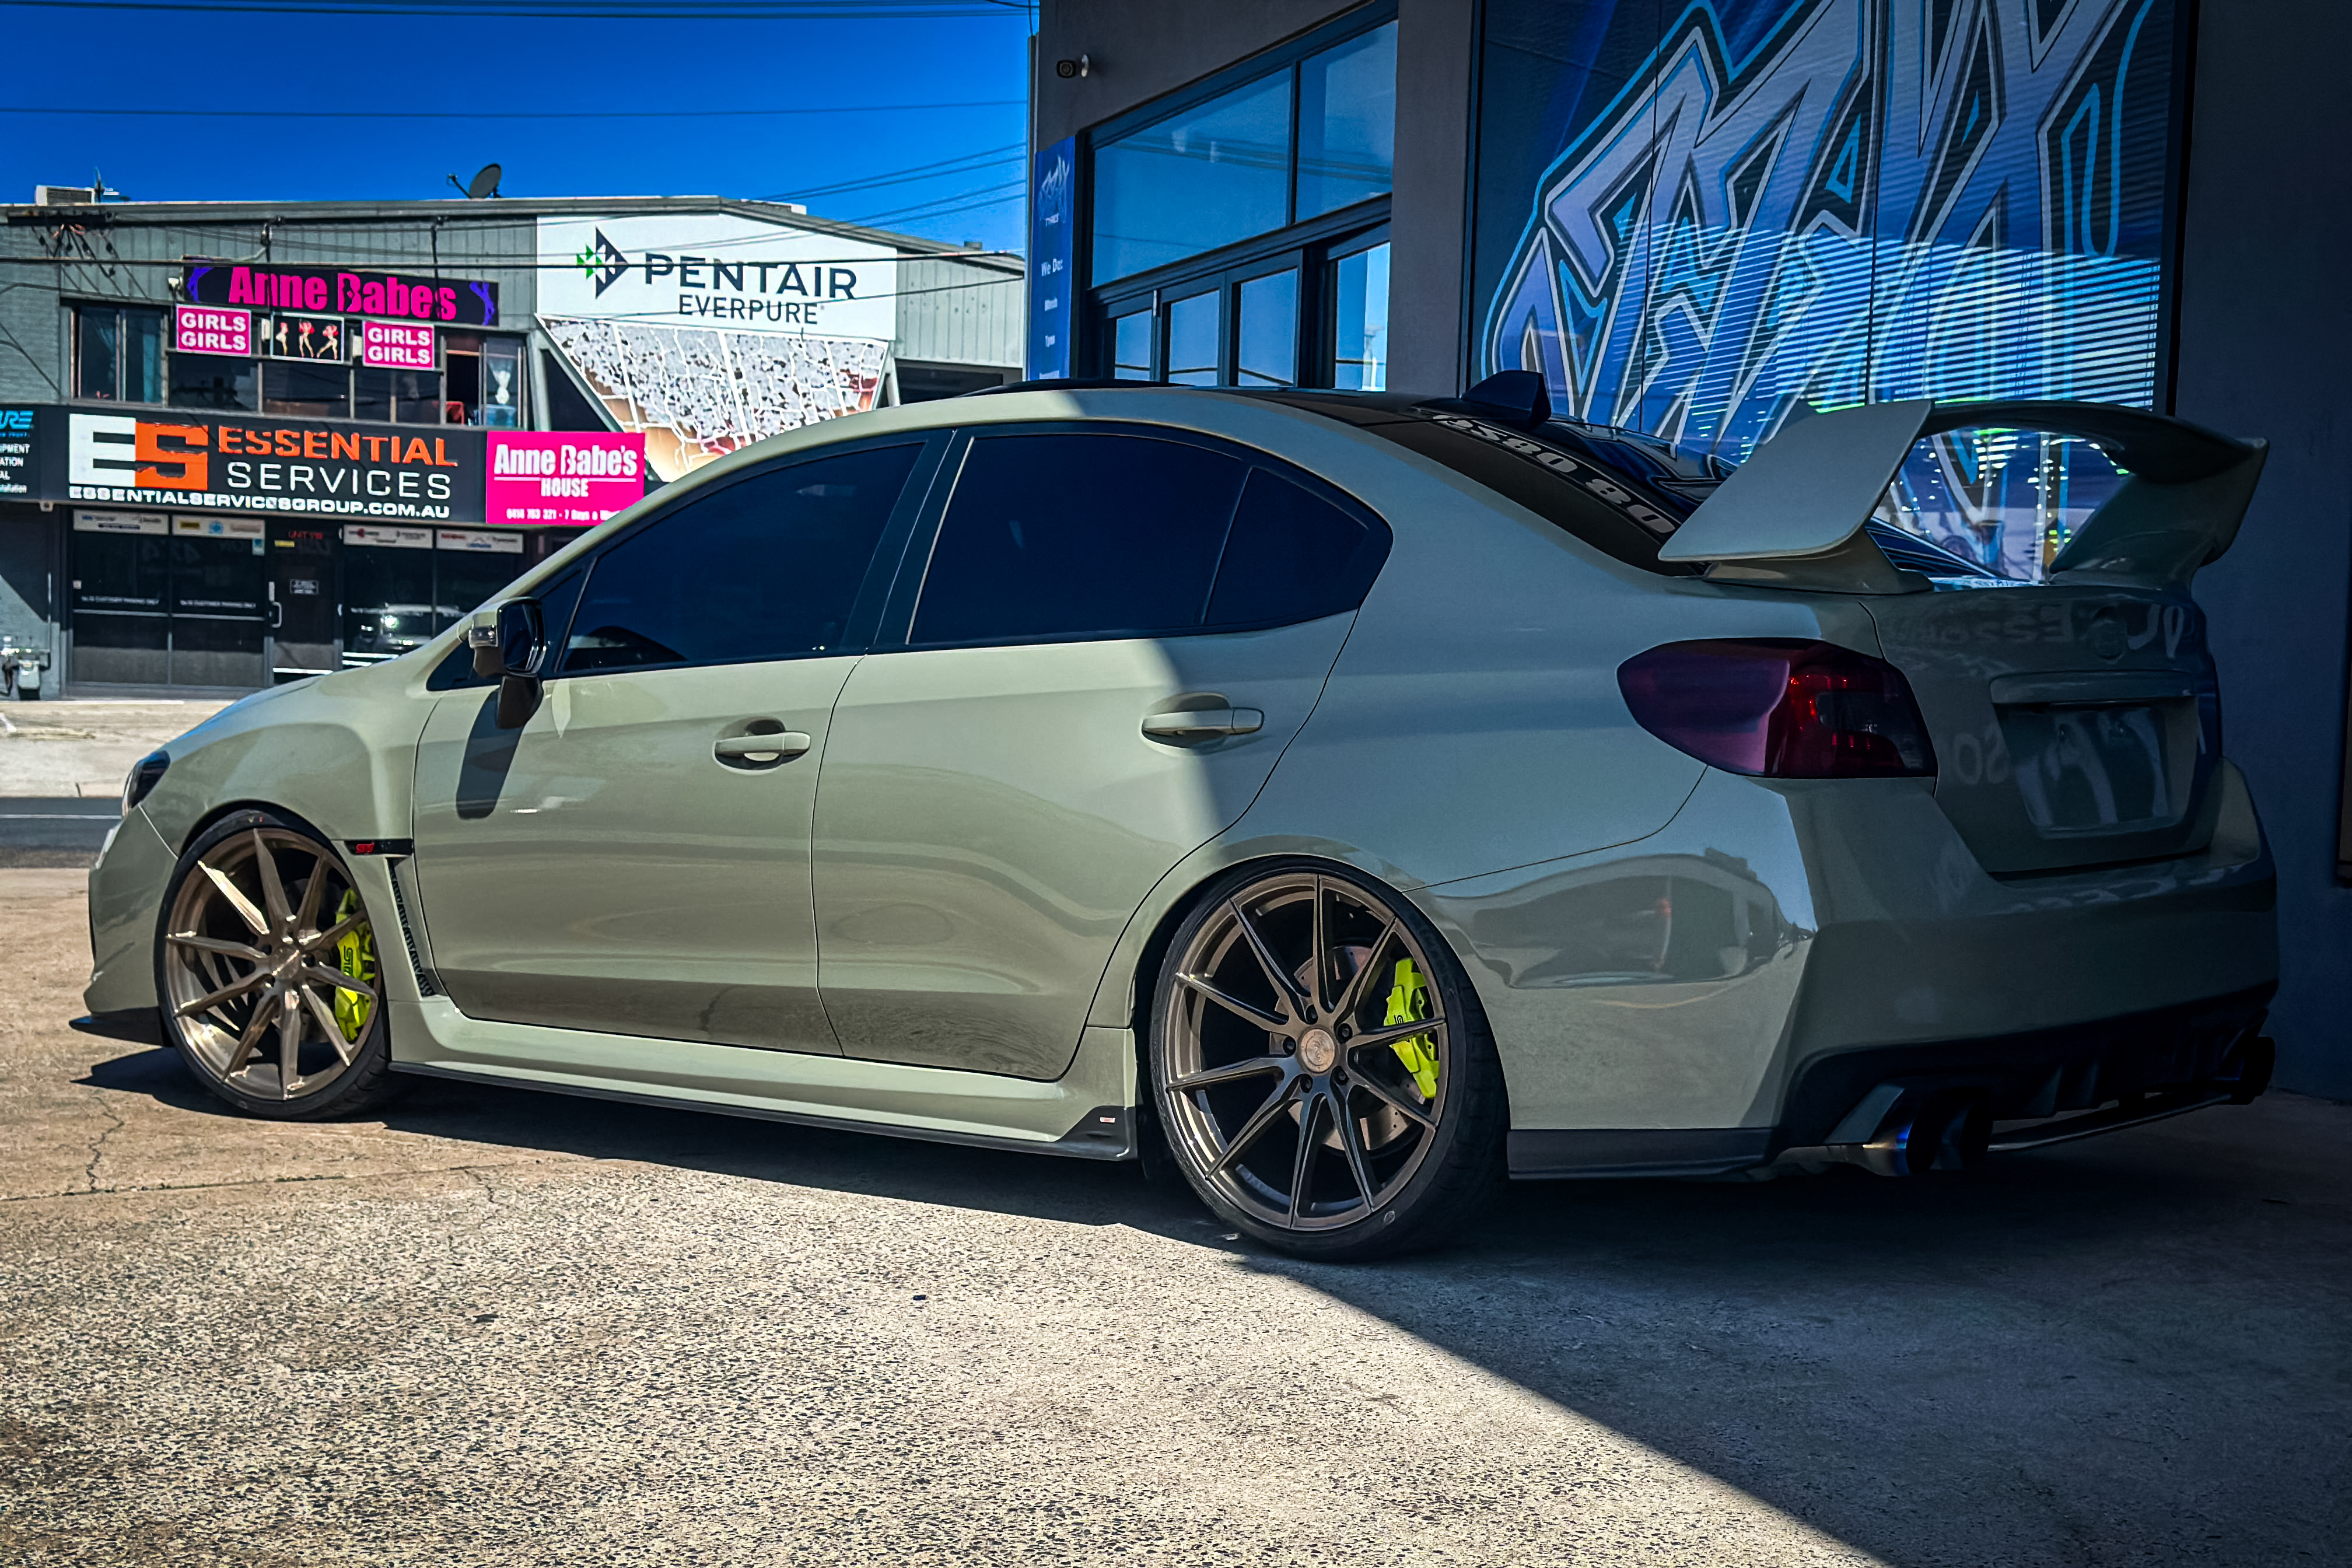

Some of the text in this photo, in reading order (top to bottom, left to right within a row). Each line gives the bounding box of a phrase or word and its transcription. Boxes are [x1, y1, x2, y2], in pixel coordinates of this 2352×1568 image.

[645, 252, 856, 299] PENTAIR
[229, 267, 457, 321] Anne Babes
[679, 294, 818, 325] EVERPURE
[181, 312, 246, 332] GIRLS
[368, 327, 430, 346] GIRLS
[181, 331, 246, 351] GIRLS
[368, 345, 430, 365] GIRLS
[219, 425, 458, 467] ESSENTIAL
[494, 444, 637, 476] Anne Babe's
[228, 462, 450, 499] SERVICES
[541, 478, 589, 498] HOUSE
[69, 486, 450, 518] ESSENTIALSERVICESGROUP.COM.AU
